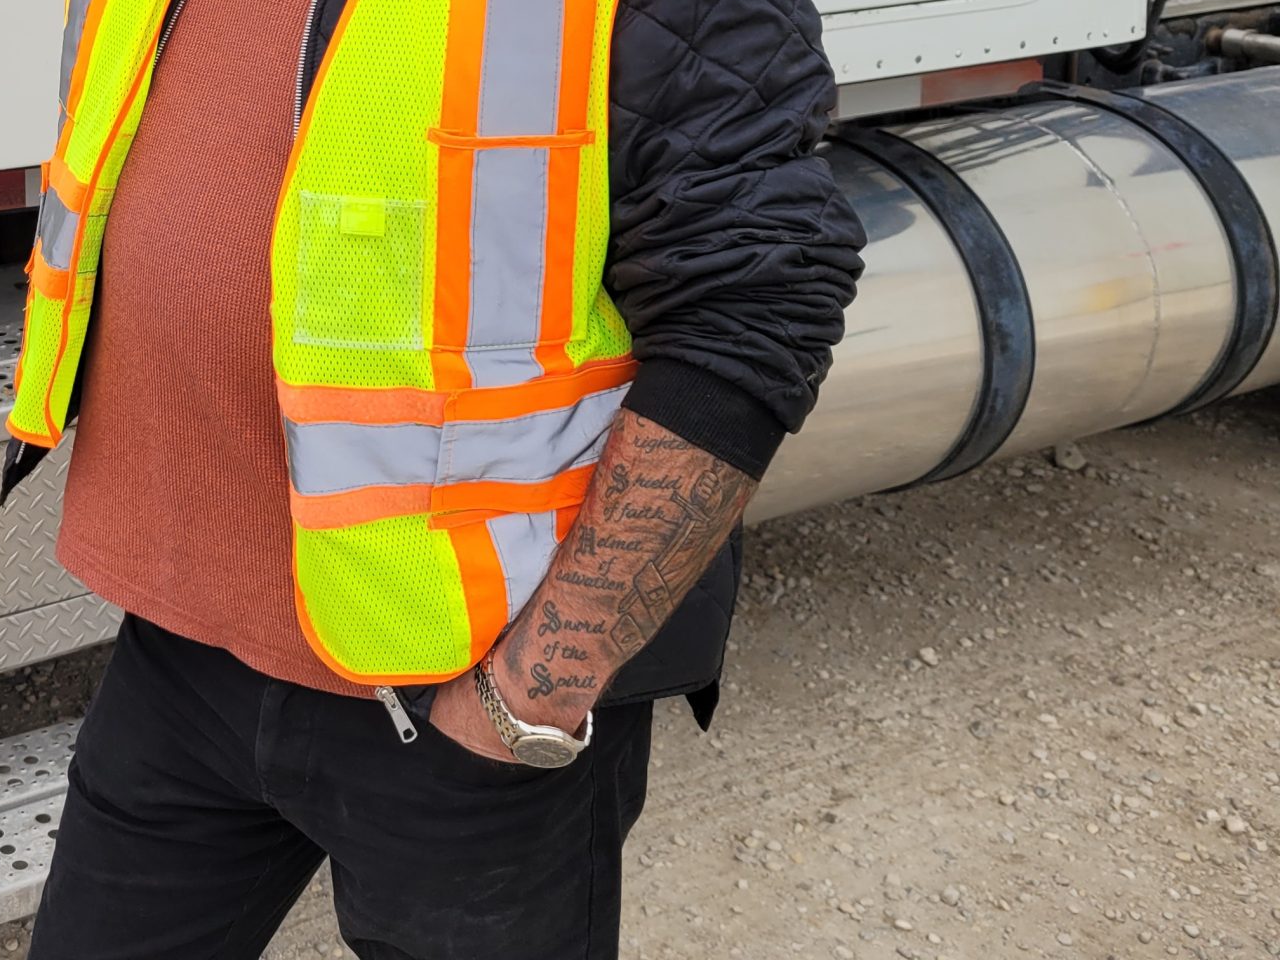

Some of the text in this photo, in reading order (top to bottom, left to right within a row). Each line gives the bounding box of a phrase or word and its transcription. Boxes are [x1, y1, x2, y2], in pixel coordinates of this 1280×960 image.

[616, 503, 665, 522] faith
[598, 556, 618, 577] of
[538, 600, 607, 637] Sword
[543, 641, 588, 662] of the
[528, 663, 597, 700] Spirit
